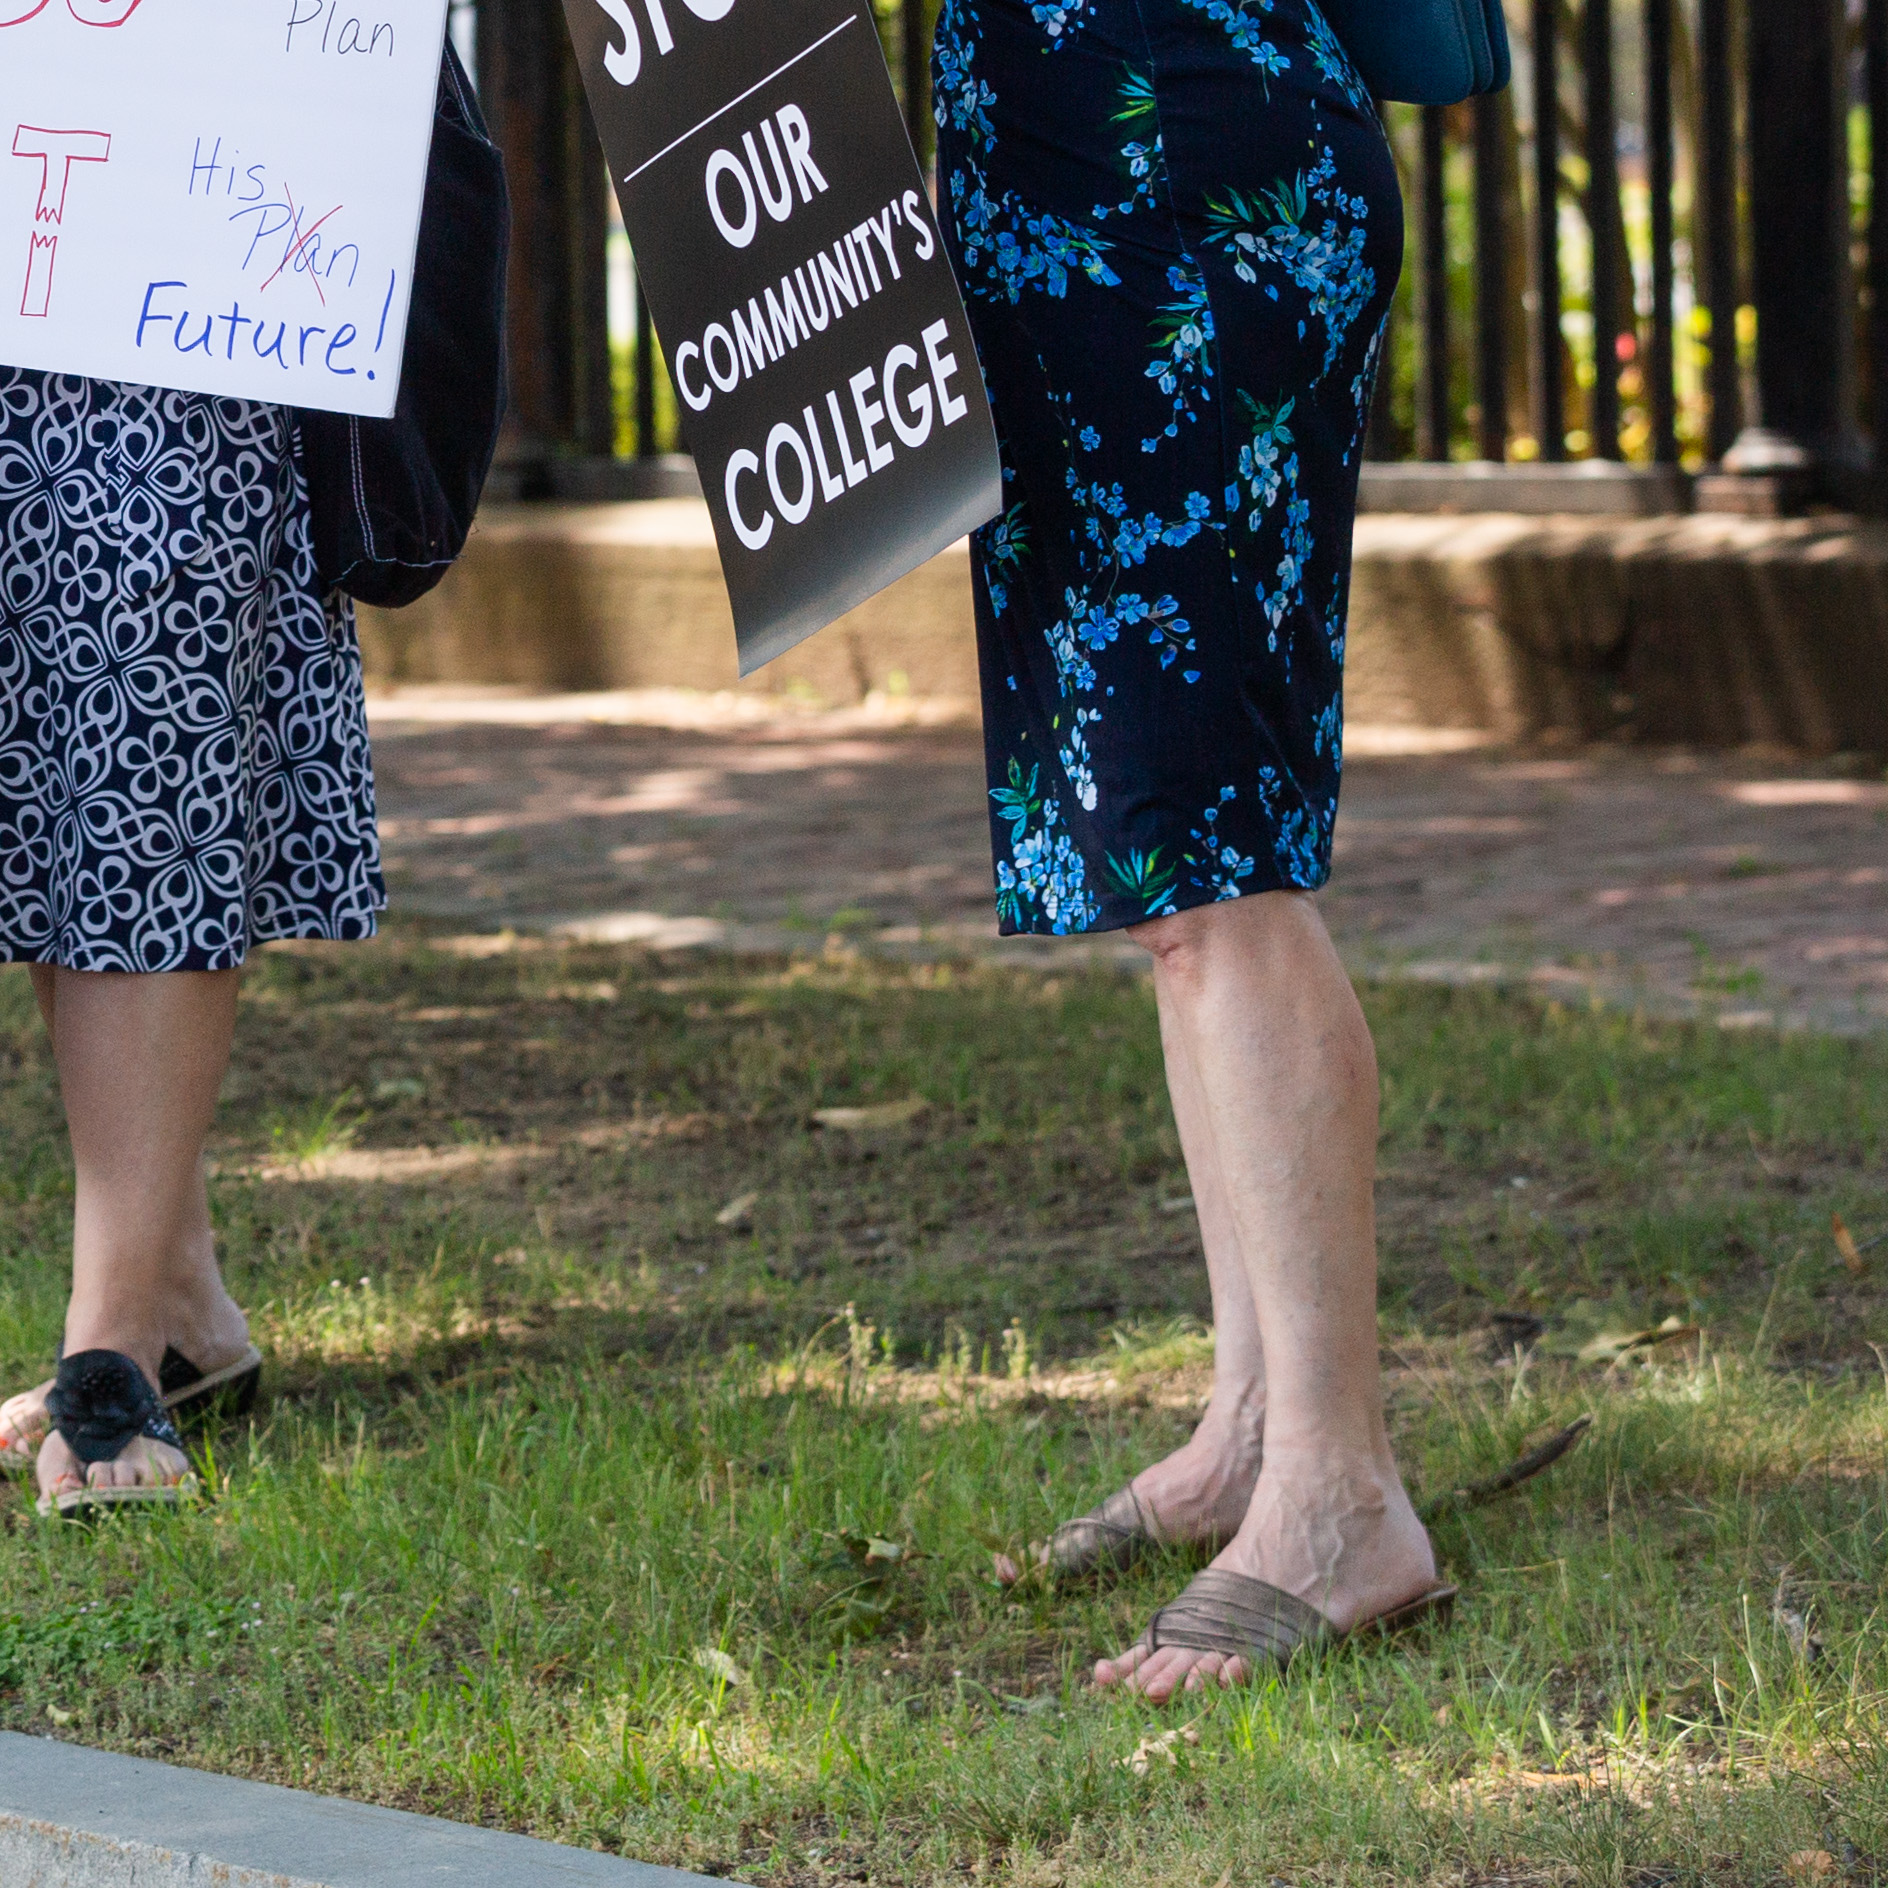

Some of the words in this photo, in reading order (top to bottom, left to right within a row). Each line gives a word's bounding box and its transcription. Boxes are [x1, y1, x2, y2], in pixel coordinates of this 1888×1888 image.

[188, 135, 266, 201] His
[704, 102, 828, 249] OUR
[134, 267, 396, 381] Future!
[675, 188, 935, 414] COMMUNITY'S
[723, 317, 968, 552] COLLEGE
